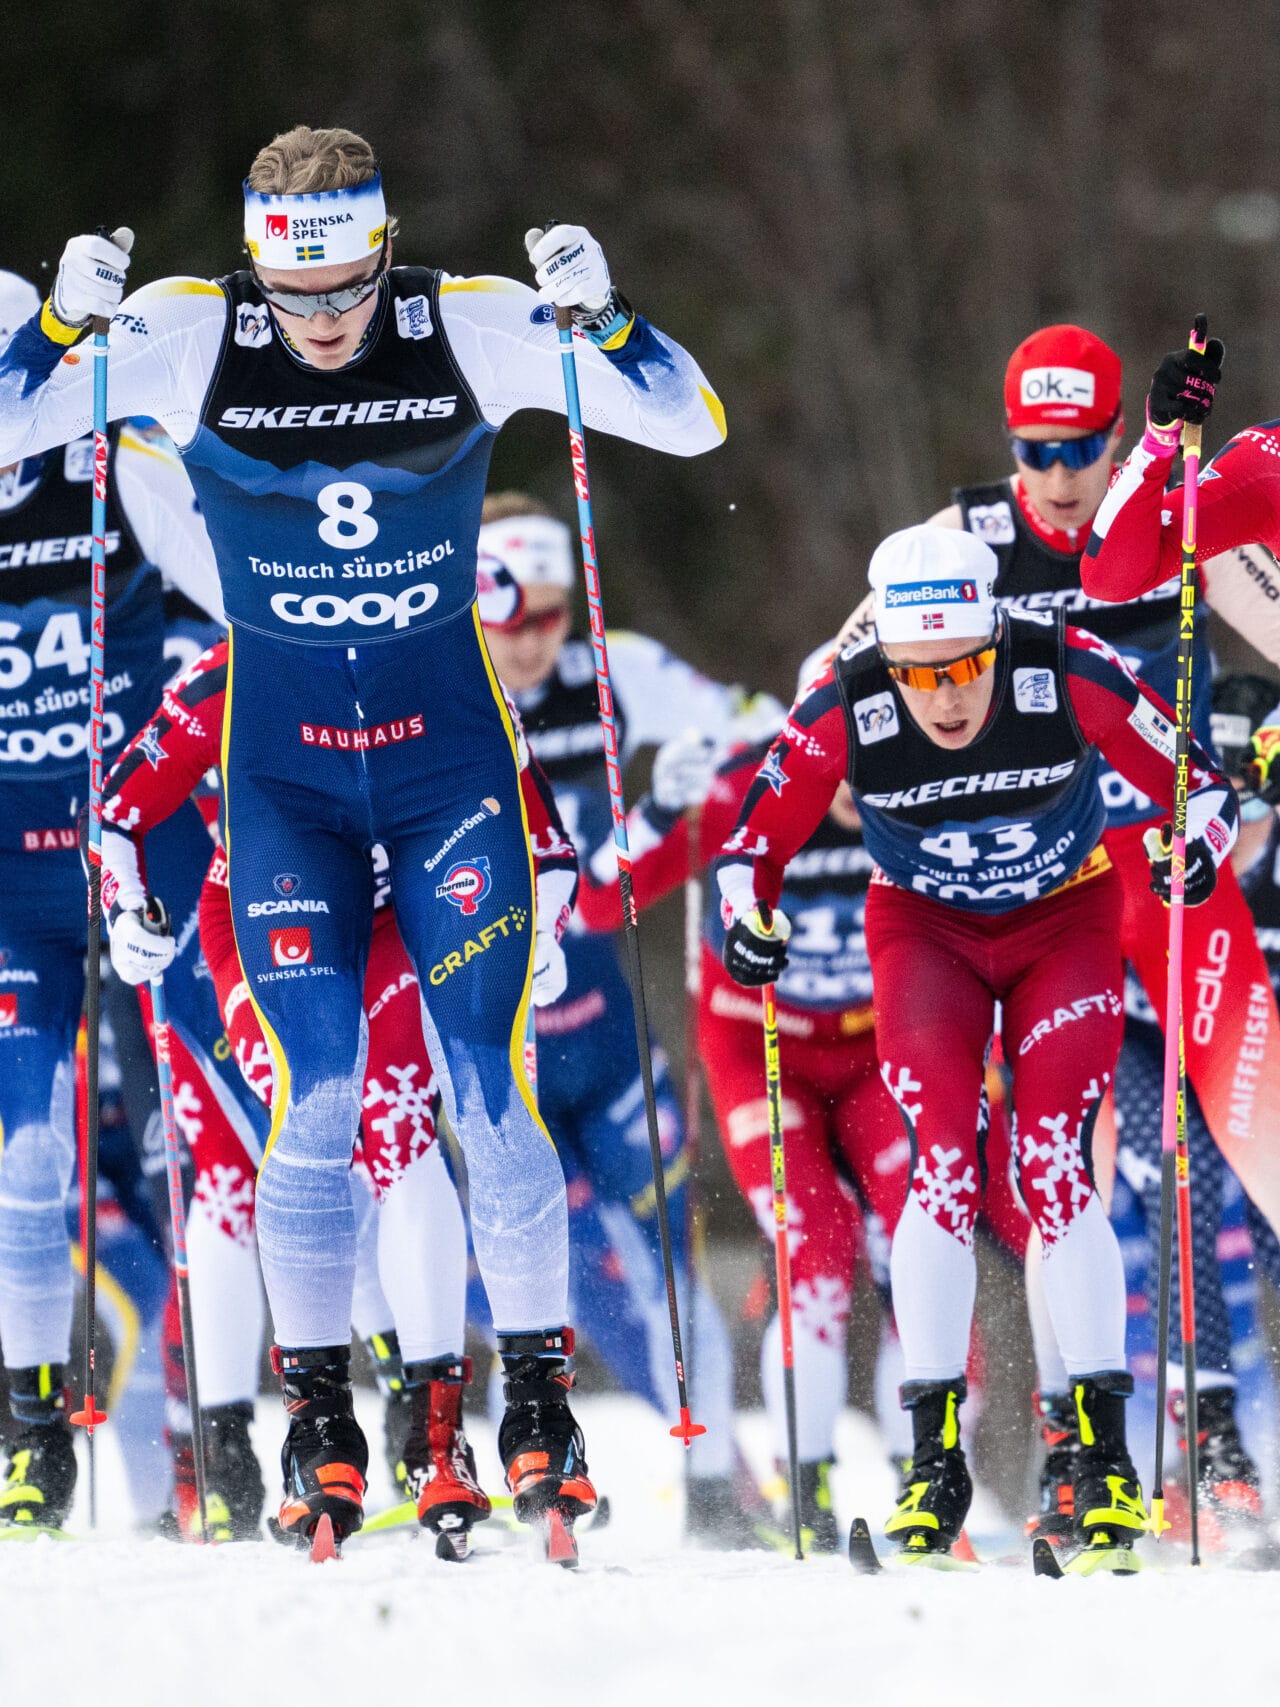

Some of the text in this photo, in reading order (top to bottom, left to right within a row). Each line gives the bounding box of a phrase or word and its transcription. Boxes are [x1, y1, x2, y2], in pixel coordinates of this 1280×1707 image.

[293, 213, 354, 229] SVENSKA
[293, 228, 328, 240] SPEL
[218, 395, 457, 430] SKECHERS
[317, 481, 379, 549] 8
[248, 555, 335, 579] Toblach
[270, 582, 439, 630] coop
[886, 584, 960, 607] SpareBank
[1180, 562, 1196, 640] LEKI
[302, 716, 423, 749] BAUHAUS
[862, 760, 1076, 809] SKECHERS
[423, 810, 487, 873] Sundström
[920, 822, 1038, 867] 43
[247, 899, 330, 918] SCANIA
[436, 877, 476, 898] Thermia
[430, 915, 510, 986] CRAFT
[256, 966, 337, 983] SVENSKA SPEL
[1192, 928, 1231, 1045] odlo
[1018, 993, 1108, 1056] CRAFT
[1227, 981, 1270, 1139] RAIFFEISEN
